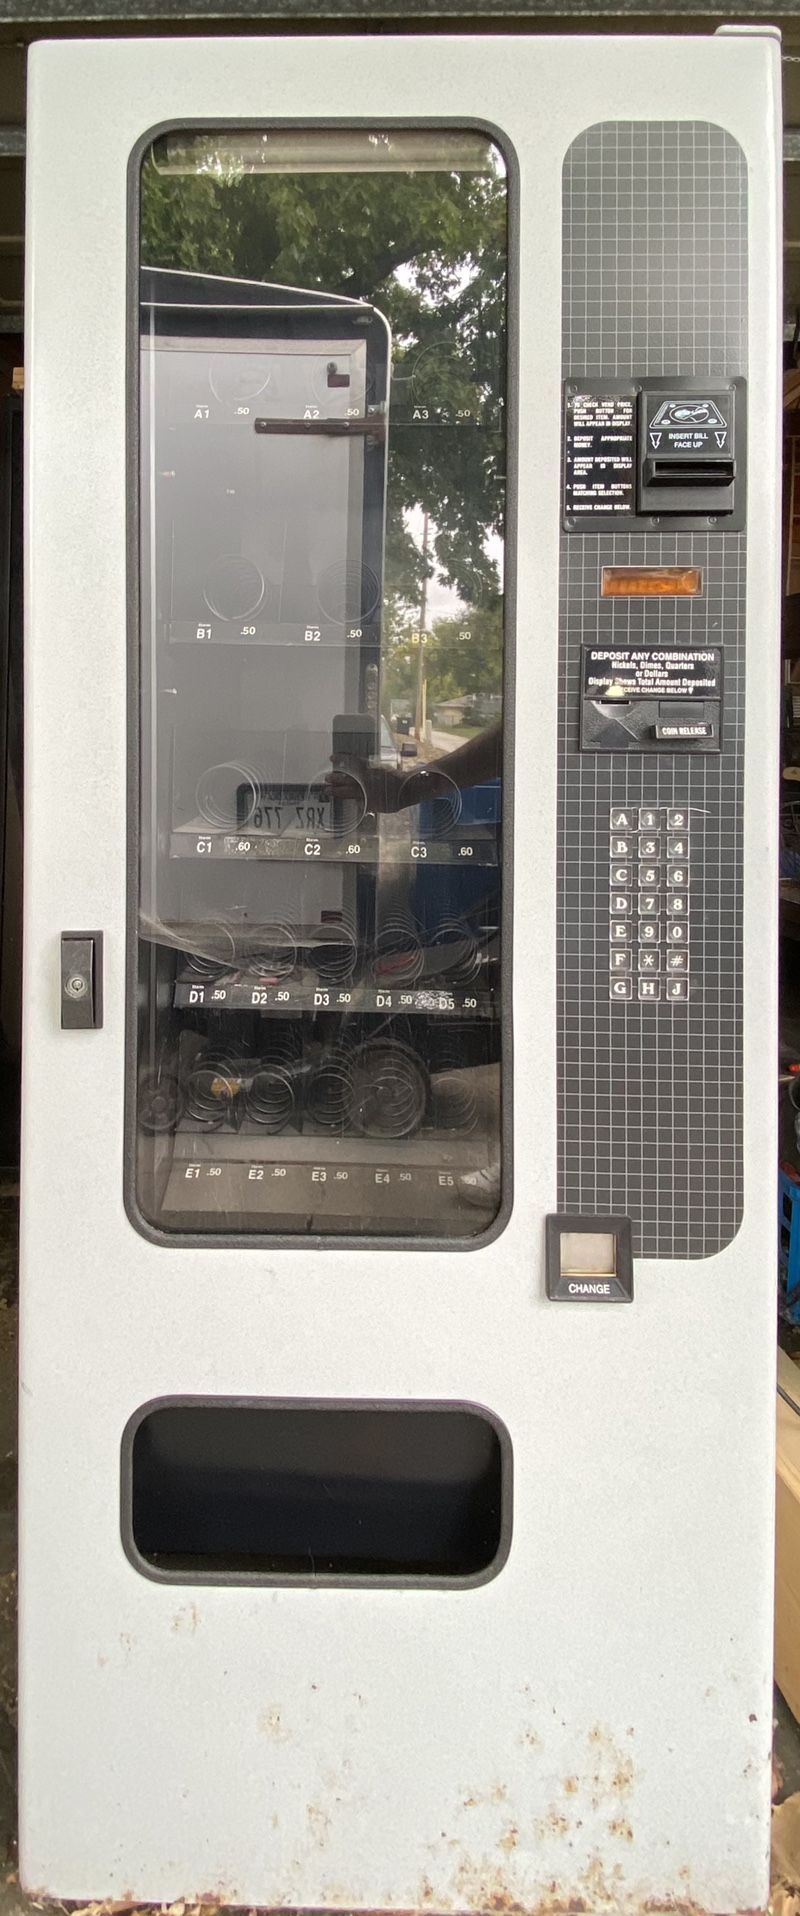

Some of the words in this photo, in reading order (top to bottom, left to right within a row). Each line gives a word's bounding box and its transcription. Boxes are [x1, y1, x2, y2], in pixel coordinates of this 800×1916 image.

[194, 409, 210, 419] A1
[234, 407, 250, 415] .50
[303, 410, 320, 419] A2
[345, 408, 360, 416] .50
[412, 409, 429, 419] A3
[668, 432, 692, 440] INSERT
[196, 628, 212, 639] B1
[240, 626, 256, 635] .50
[304, 630, 321, 641] B2
[346, 629, 363, 638] .50
[411, 632, 428, 643] B3
[591, 651, 629, 660] DEPOSIT
[631, 652, 650, 660] ANY
[651, 652, 715, 661] COMBINATION
[611, 661, 639, 670] Nickels,
[640, 662, 664, 670] Dimes,
[665, 662, 695, 670] Quarters
[643, 670, 669, 678] Dollars
[588, 677, 613, 686] Display
[682, 679, 716, 687] Deposited
[679, 727, 708, 735] RELEASE
[616, 814, 628, 826] A
[646, 815, 654, 827] 1
[674, 815, 684, 827] 2
[196, 842, 212, 853] C1
[235, 842, 251, 851] .60
[304, 843, 321, 855] C2
[345, 845, 361, 854] .60
[458, 847, 473, 856] .60
[617, 841, 628, 852] B
[645, 842, 655, 854] 3
[674, 843, 683, 855] 4
[411, 847, 427, 858] C3
[616, 869, 627, 881] C
[646, 870, 655, 882] 5
[673, 871, 683, 883] 6
[616, 897, 627, 909] D
[645, 898, 655, 910] 7
[673, 899, 683, 911] 8
[615, 925, 627, 937] E
[644, 926, 654, 938] 9
[615, 953, 626, 965] F
[614, 982, 626, 994] G
[642, 983, 655, 995] H
[672, 983, 681, 995] J
[189, 991, 205, 1003] D1
[211, 990, 226, 999] .50
[251, 992, 268, 1004] D2
[274, 992, 290, 1001] .50
[313, 994, 330, 1006] D3
[336, 993, 351, 1003] .50
[398, 995, 412, 1004] .50
[376, 995, 392, 1007] D4
[438, 997, 455, 1010] D5
[462, 998, 477, 1008] .50
[185, 1168, 201, 1178] E1
[206, 1168, 222, 1176] .50
[248, 1169, 264, 1180] E2
[271, 1168, 287, 1176] .50
[311, 1171, 327, 1182] E3
[333, 1171, 348, 1180] .50
[375, 1173, 390, 1184] E4
[438, 1176, 454, 1186] E5
[568, 1283, 611, 1294] CHANGE
